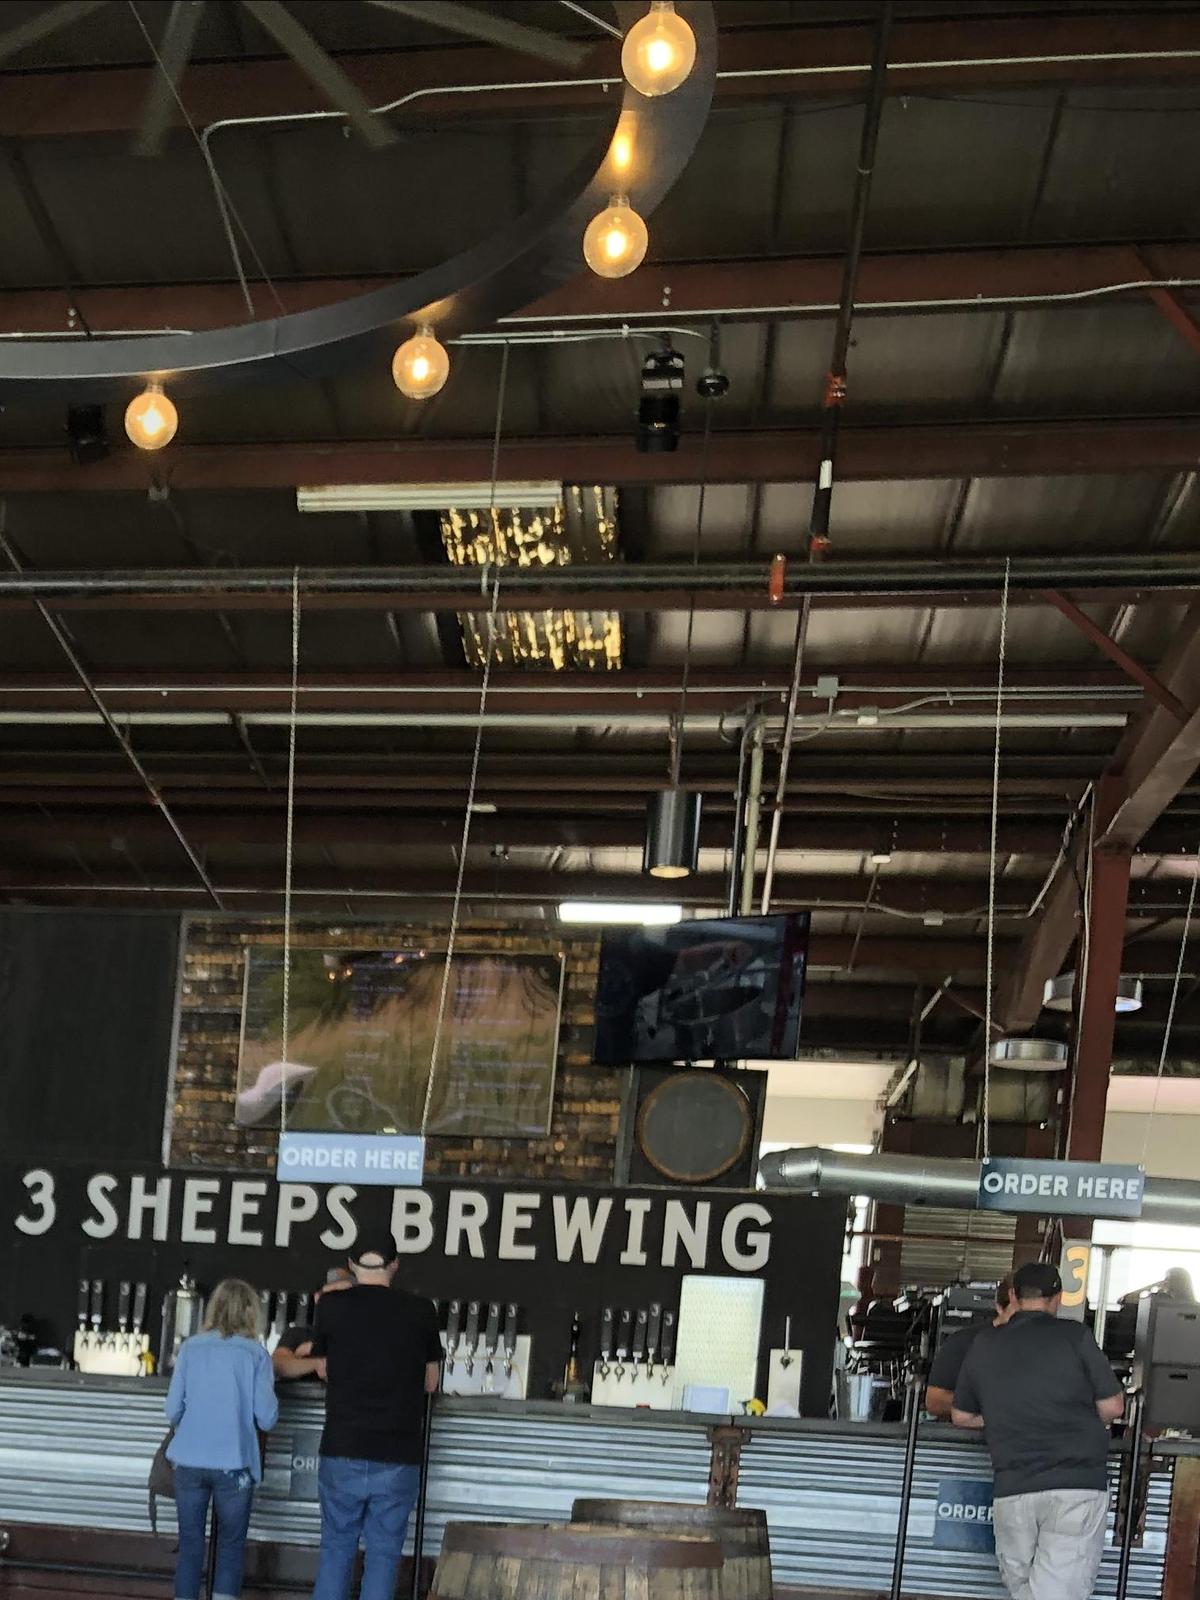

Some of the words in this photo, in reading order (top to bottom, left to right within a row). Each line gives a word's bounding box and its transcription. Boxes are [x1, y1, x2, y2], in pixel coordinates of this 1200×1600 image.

[282, 1147, 357, 1168] ORDER
[364, 1150, 420, 1171] HERE
[983, 1171, 1069, 1197] ORDER
[1076, 1175, 1140, 1201] HERE
[14, 1168, 57, 1236] 3
[80, 1174, 358, 1251] SHEEPS
[390, 1187, 773, 1272] BREWING
[1061, 1246, 1090, 1307] 3
